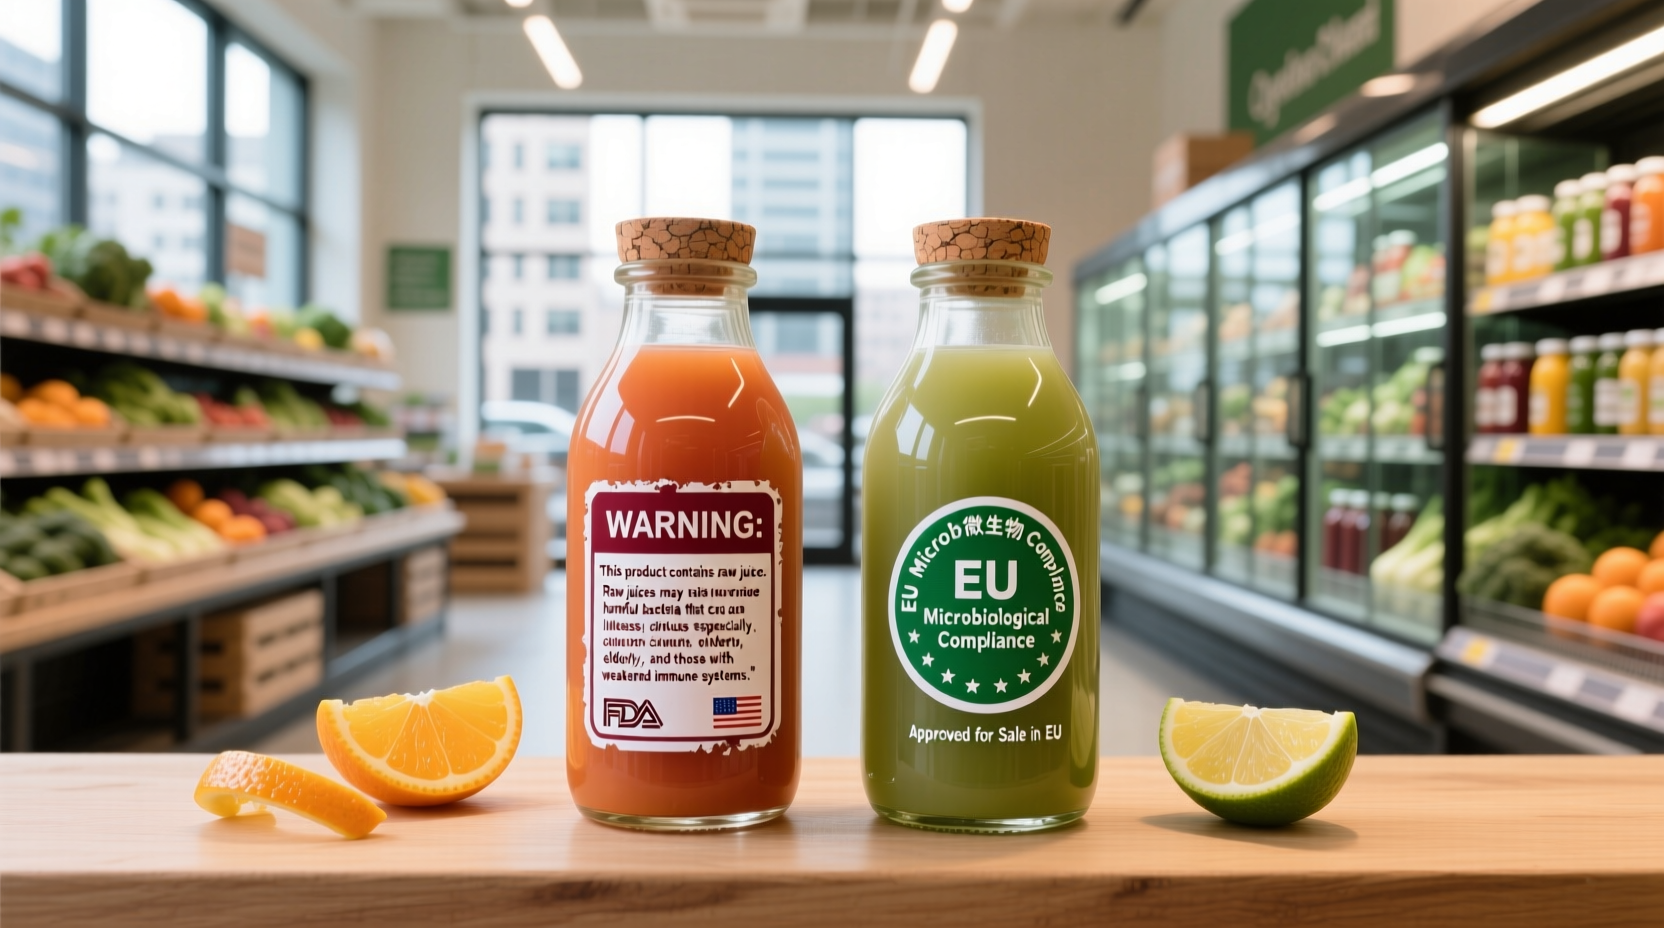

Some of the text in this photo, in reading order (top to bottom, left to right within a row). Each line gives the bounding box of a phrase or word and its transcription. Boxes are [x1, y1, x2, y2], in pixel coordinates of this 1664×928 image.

[606, 510, 762, 538] WARNING:
[600, 565, 622, 576] This
[625, 565, 666, 580] product
[670, 565, 714, 577] contains
[955, 560, 1017, 600] EU
[603, 585, 624, 597] Raw
[626, 585, 655, 600] juices
[660, 590, 683, 601] may
[901, 585, 918, 612] EU
[924, 607, 1049, 629] Microbiological
[938, 631, 1034, 653] Compliance
[650, 653, 670, 664] and
[674, 653, 706, 664] those
[710, 651, 734, 664] with
[655, 670, 698, 681] immune
[604, 698, 663, 729] FDA
[909, 724, 1061, 744] Approved for Sale in EU
